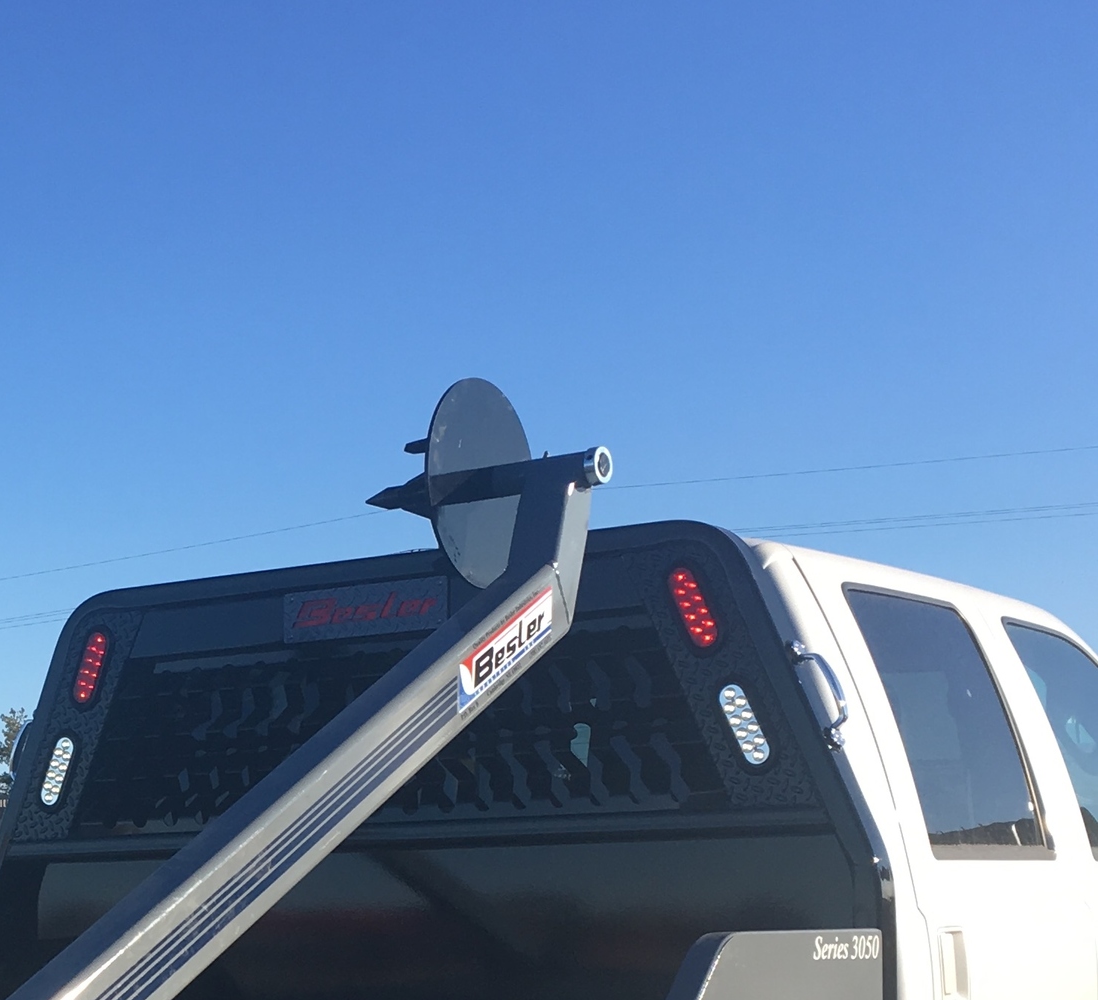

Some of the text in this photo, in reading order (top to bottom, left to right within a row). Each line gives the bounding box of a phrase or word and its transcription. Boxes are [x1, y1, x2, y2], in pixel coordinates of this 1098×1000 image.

[293, 591, 437, 628] Besler
[474, 611, 545, 689] Besler
[813, 935, 880, 960] Series 3050
